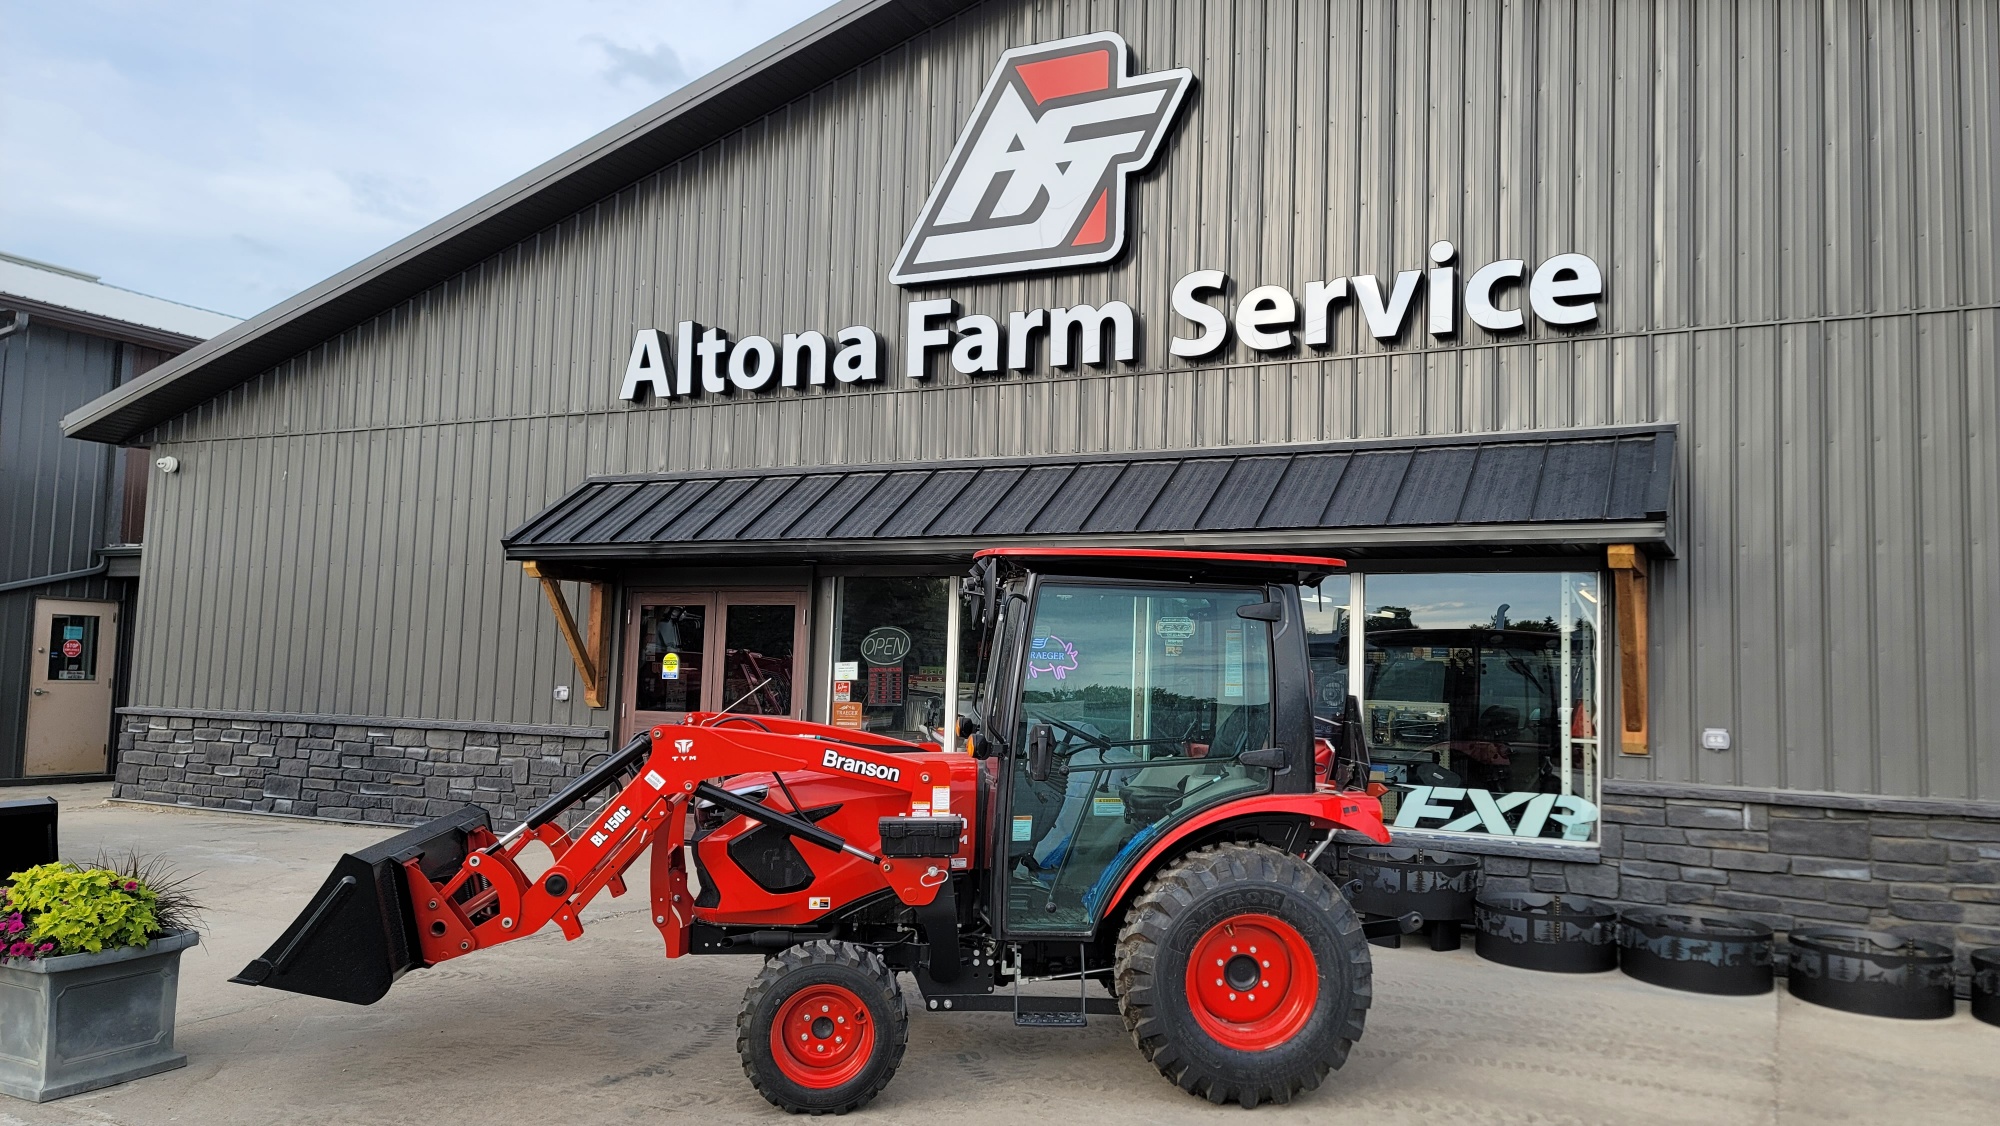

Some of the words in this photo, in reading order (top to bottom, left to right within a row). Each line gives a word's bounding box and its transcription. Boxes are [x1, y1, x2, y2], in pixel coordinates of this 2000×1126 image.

[618, 319, 878, 399] Altona
[906, 297, 1136, 377] Farm
[1169, 240, 1603, 358] Service
[863, 637, 906, 656] OPEN
[1030, 651, 1065, 660] RAEGER
[822, 749, 900, 782] Branson
[589, 831, 609, 848] BL
[603, 804, 632, 833] 150C
[1393, 783, 1598, 842] FXR
